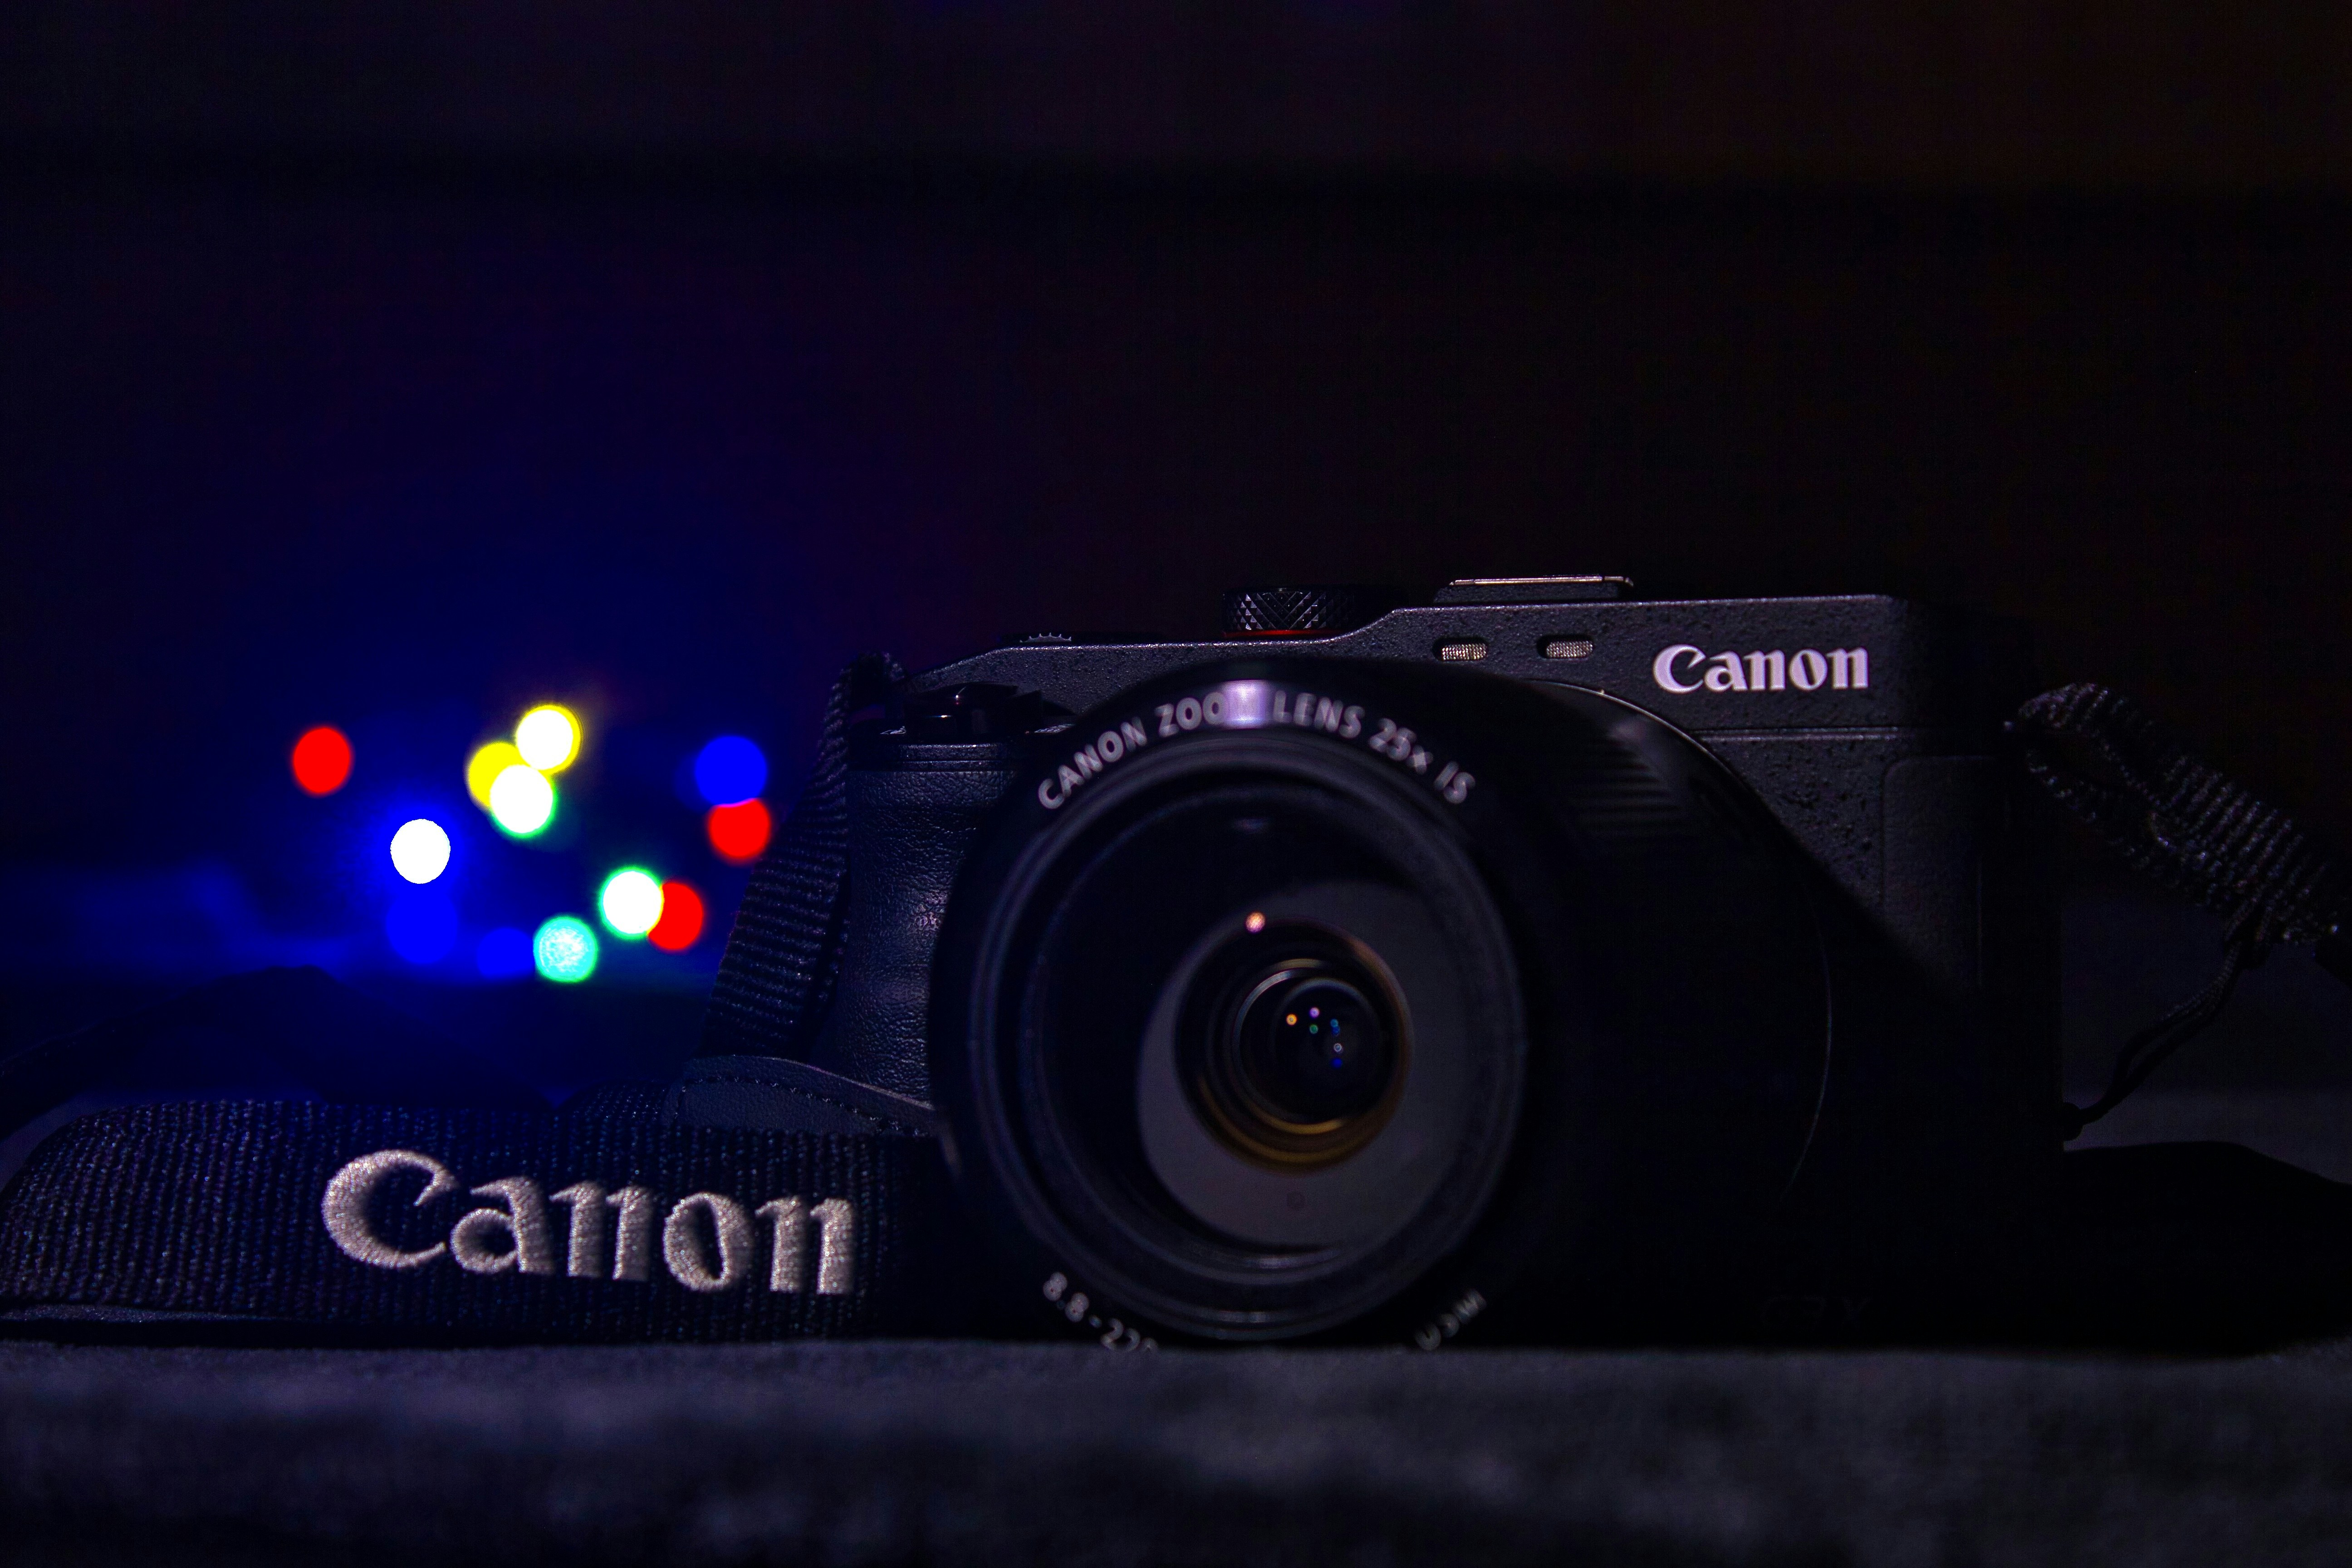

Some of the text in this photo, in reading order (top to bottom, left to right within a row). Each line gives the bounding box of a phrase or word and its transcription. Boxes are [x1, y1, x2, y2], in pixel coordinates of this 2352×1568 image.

[1653, 643, 1869, 694] Canon
[1038, 716, 1147, 809] CANON
[1155, 687, 1267, 738] ZOO
[1272, 690, 1365, 738] LENS
[1433, 761, 1475, 804] IS
[321, 1149, 858, 1295] Canon
